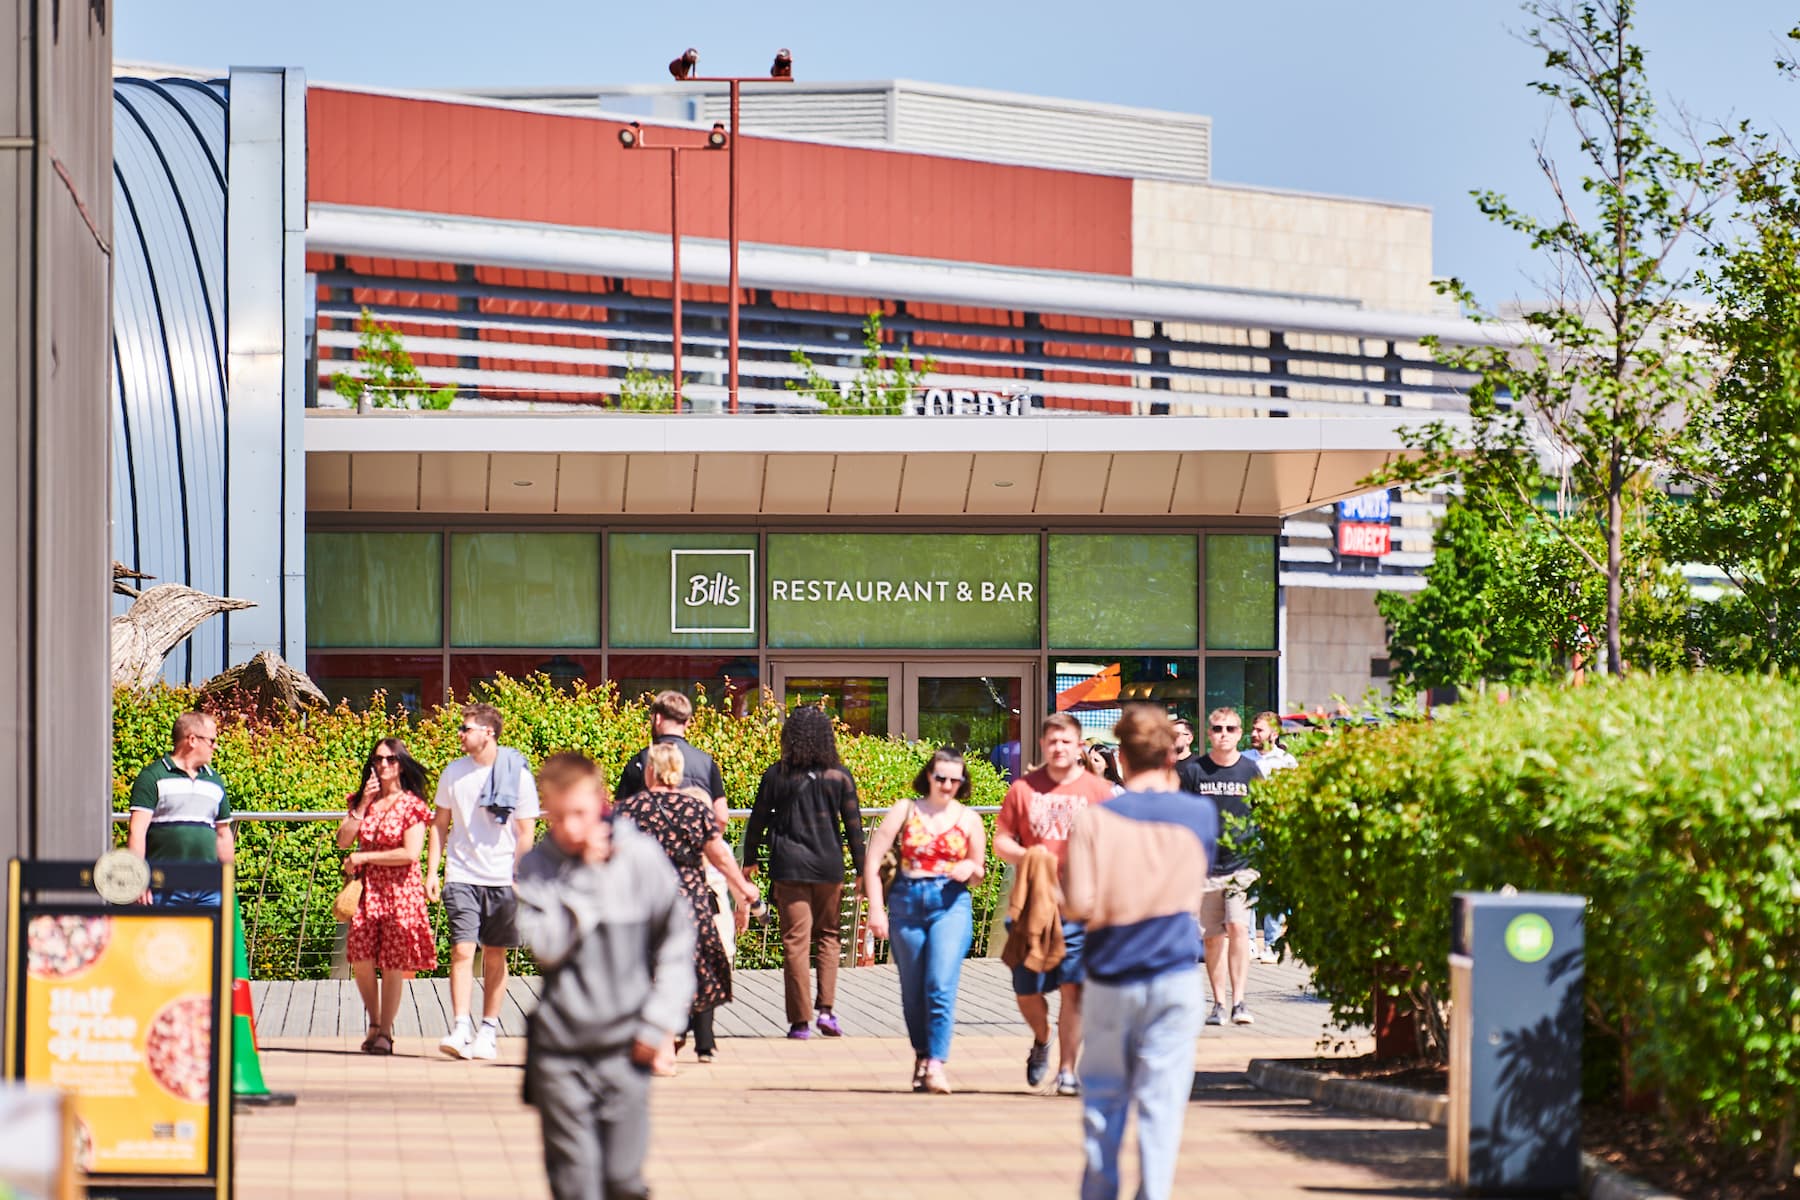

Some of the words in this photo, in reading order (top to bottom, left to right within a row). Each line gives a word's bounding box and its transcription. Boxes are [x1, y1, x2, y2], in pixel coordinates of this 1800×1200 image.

[1343, 525, 1388, 554] DIRECT
[684, 571, 741, 607] Bill's
[772, 580, 950, 602] RESTAURANT
[956, 581, 974, 602] &
[980, 581, 1035, 602] BAR
